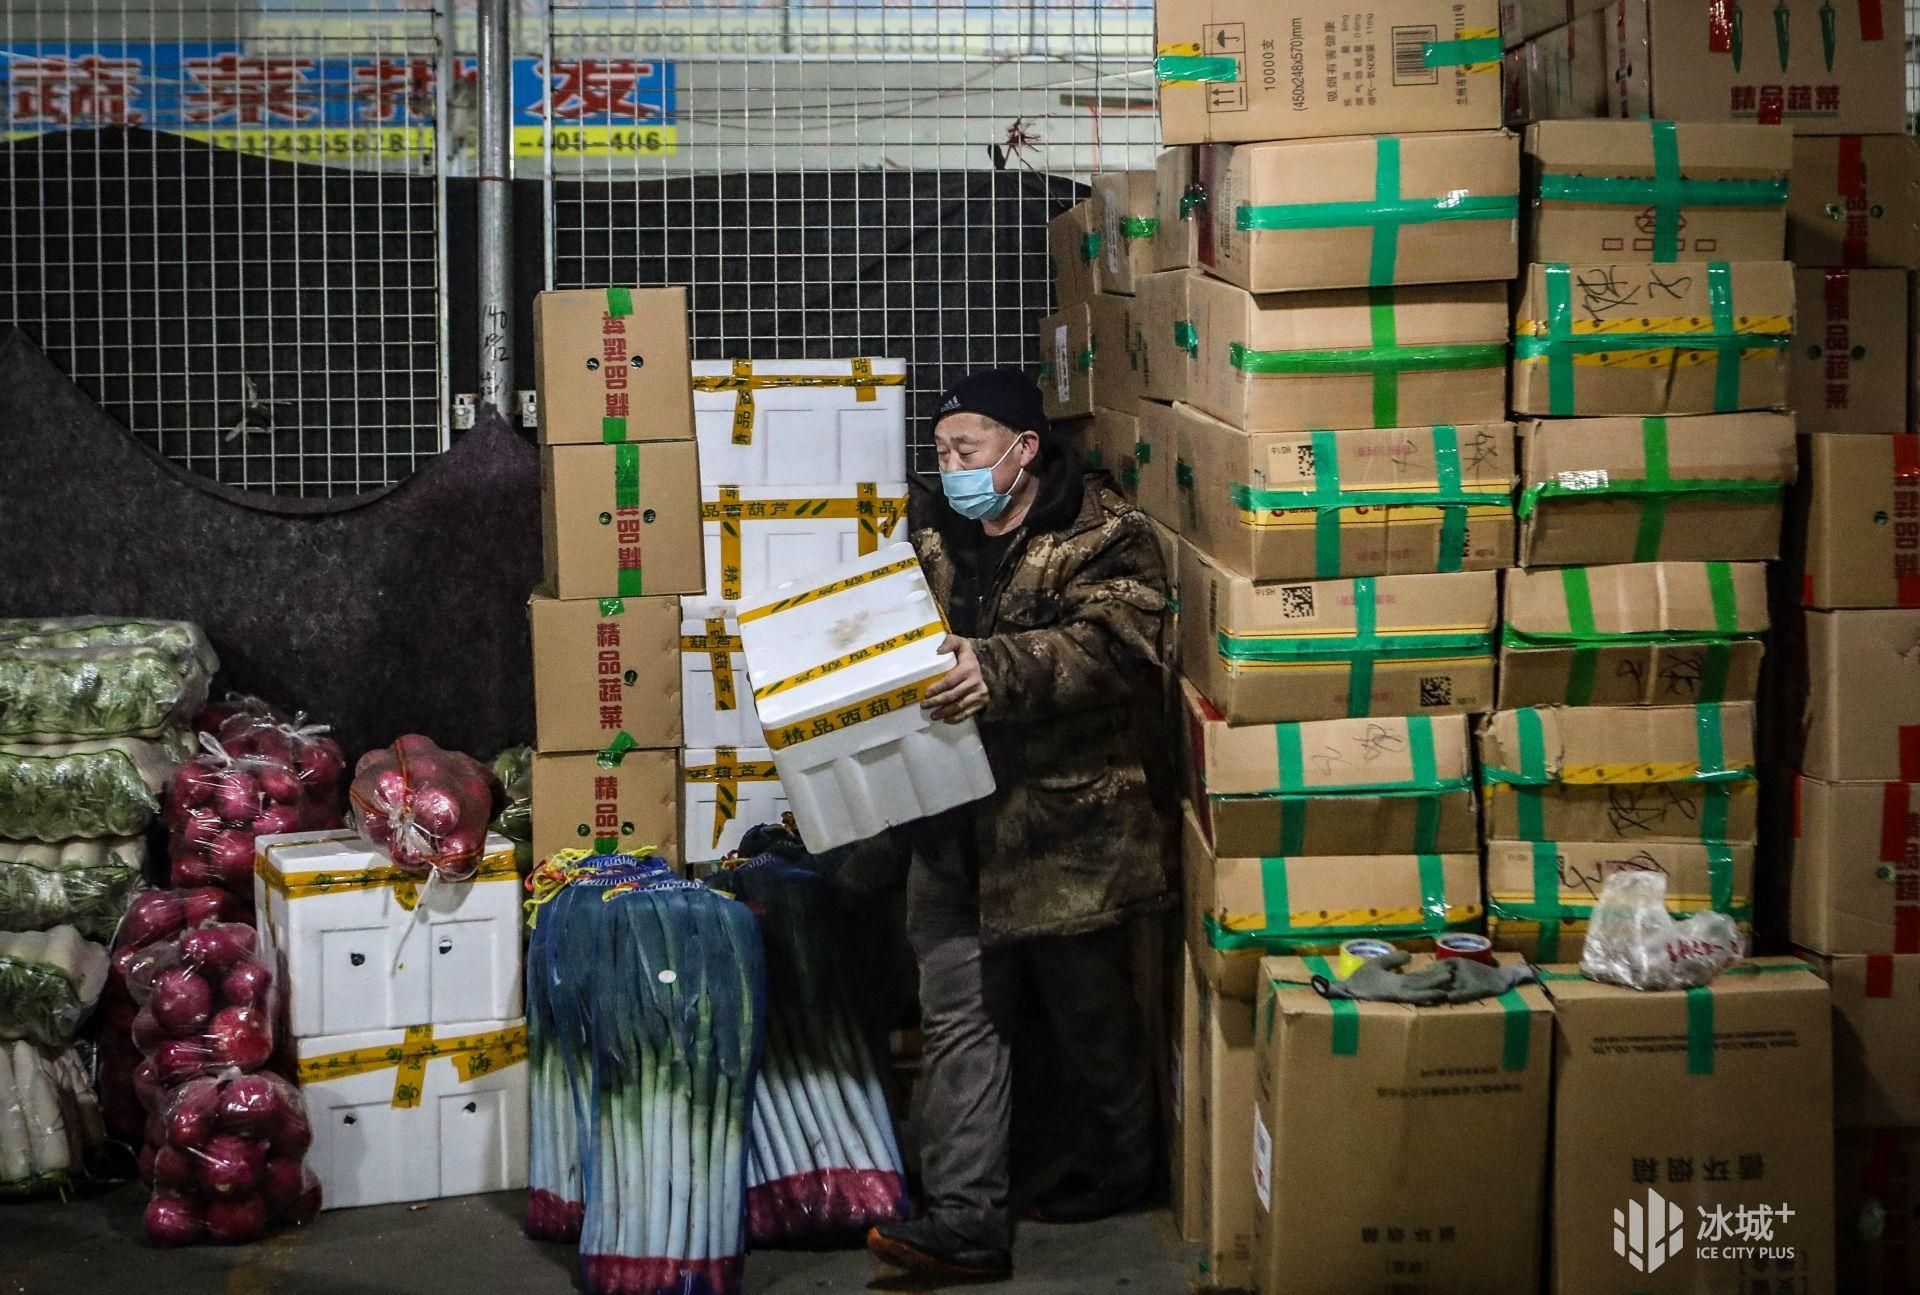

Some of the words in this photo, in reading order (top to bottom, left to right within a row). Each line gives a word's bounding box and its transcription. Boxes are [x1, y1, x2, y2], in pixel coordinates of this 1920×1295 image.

[1262, 38, 1276, 92] 10000支
[1325, 21, 1338, 103] 吸烟有害健康
[702, 500, 789, 518] 品西葫芦
[597, 622, 623, 730] 精品蔬菜
[781, 687, 919, 745] 精品西葫芦
[595, 776, 619, 839] 精品
